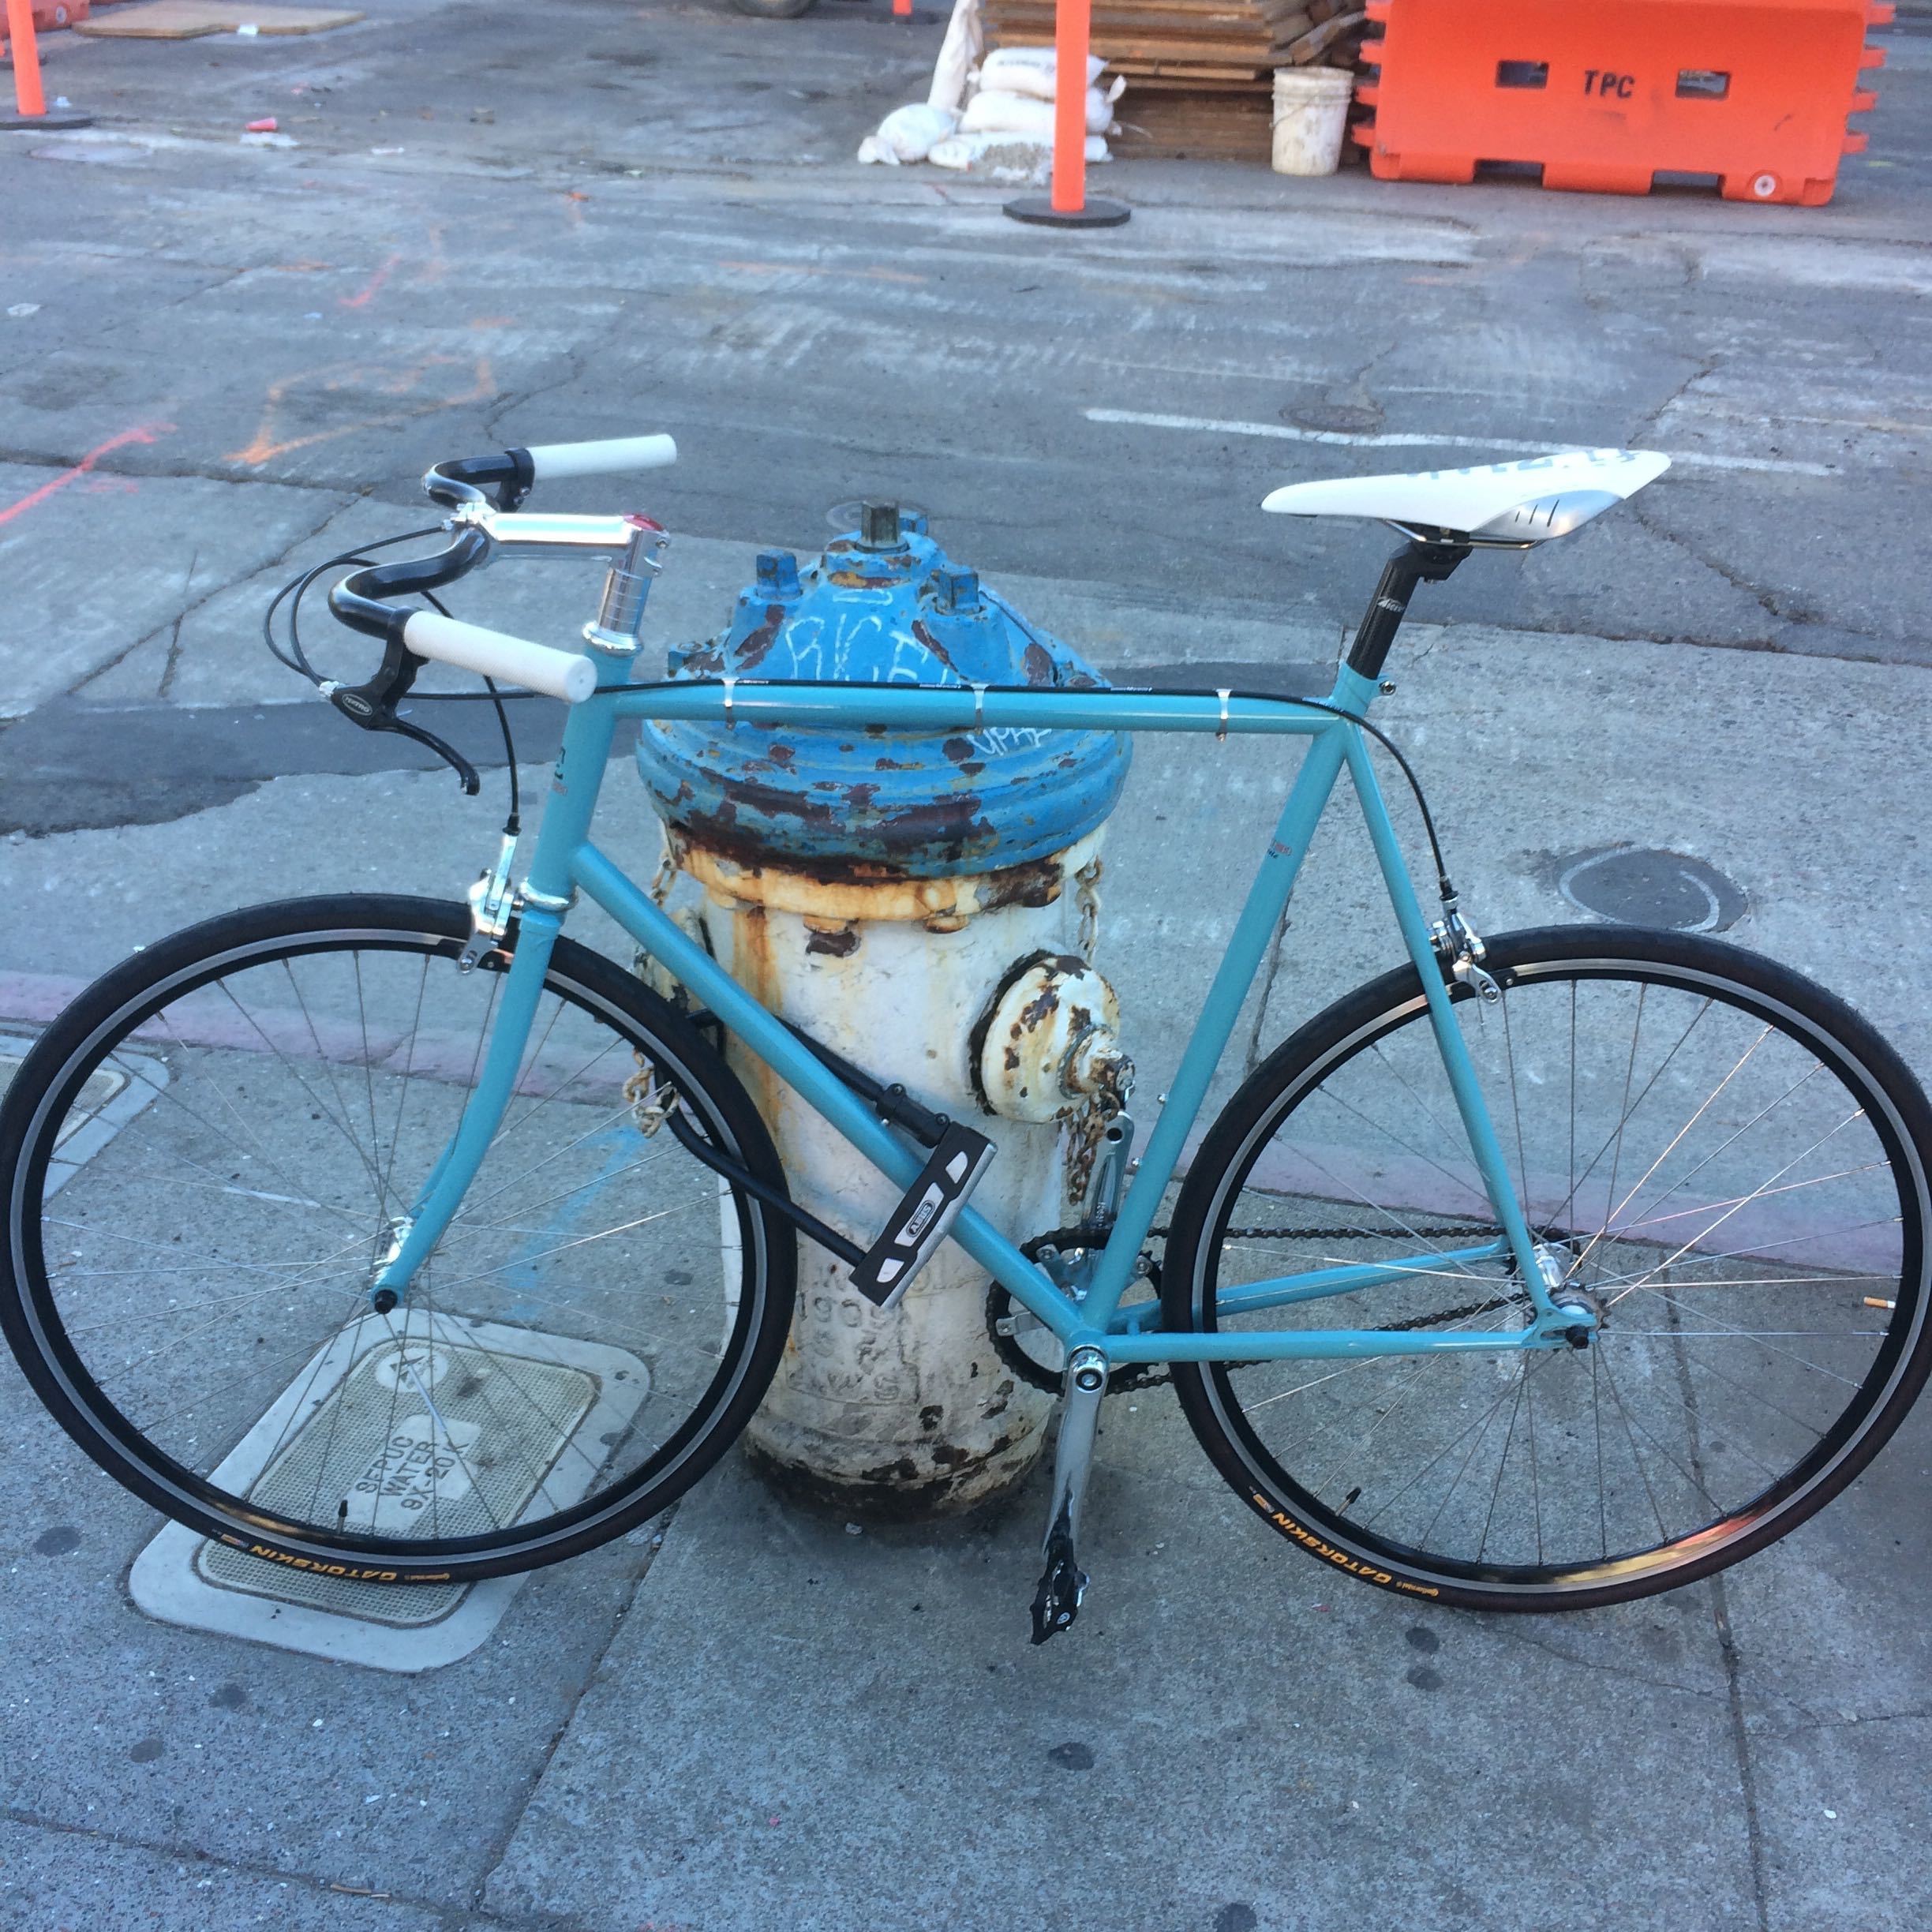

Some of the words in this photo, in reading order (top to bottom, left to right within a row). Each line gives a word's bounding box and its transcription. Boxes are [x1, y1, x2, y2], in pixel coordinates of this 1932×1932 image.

[1585, 69, 1635, 99] TPC
[355, 1436, 414, 1493] SFPUC
[379, 1441, 440, 1496] WATER
[250, 1544, 398, 1582] GATORSKIN
[1271, 1512, 1393, 1585] GATORSKIN
